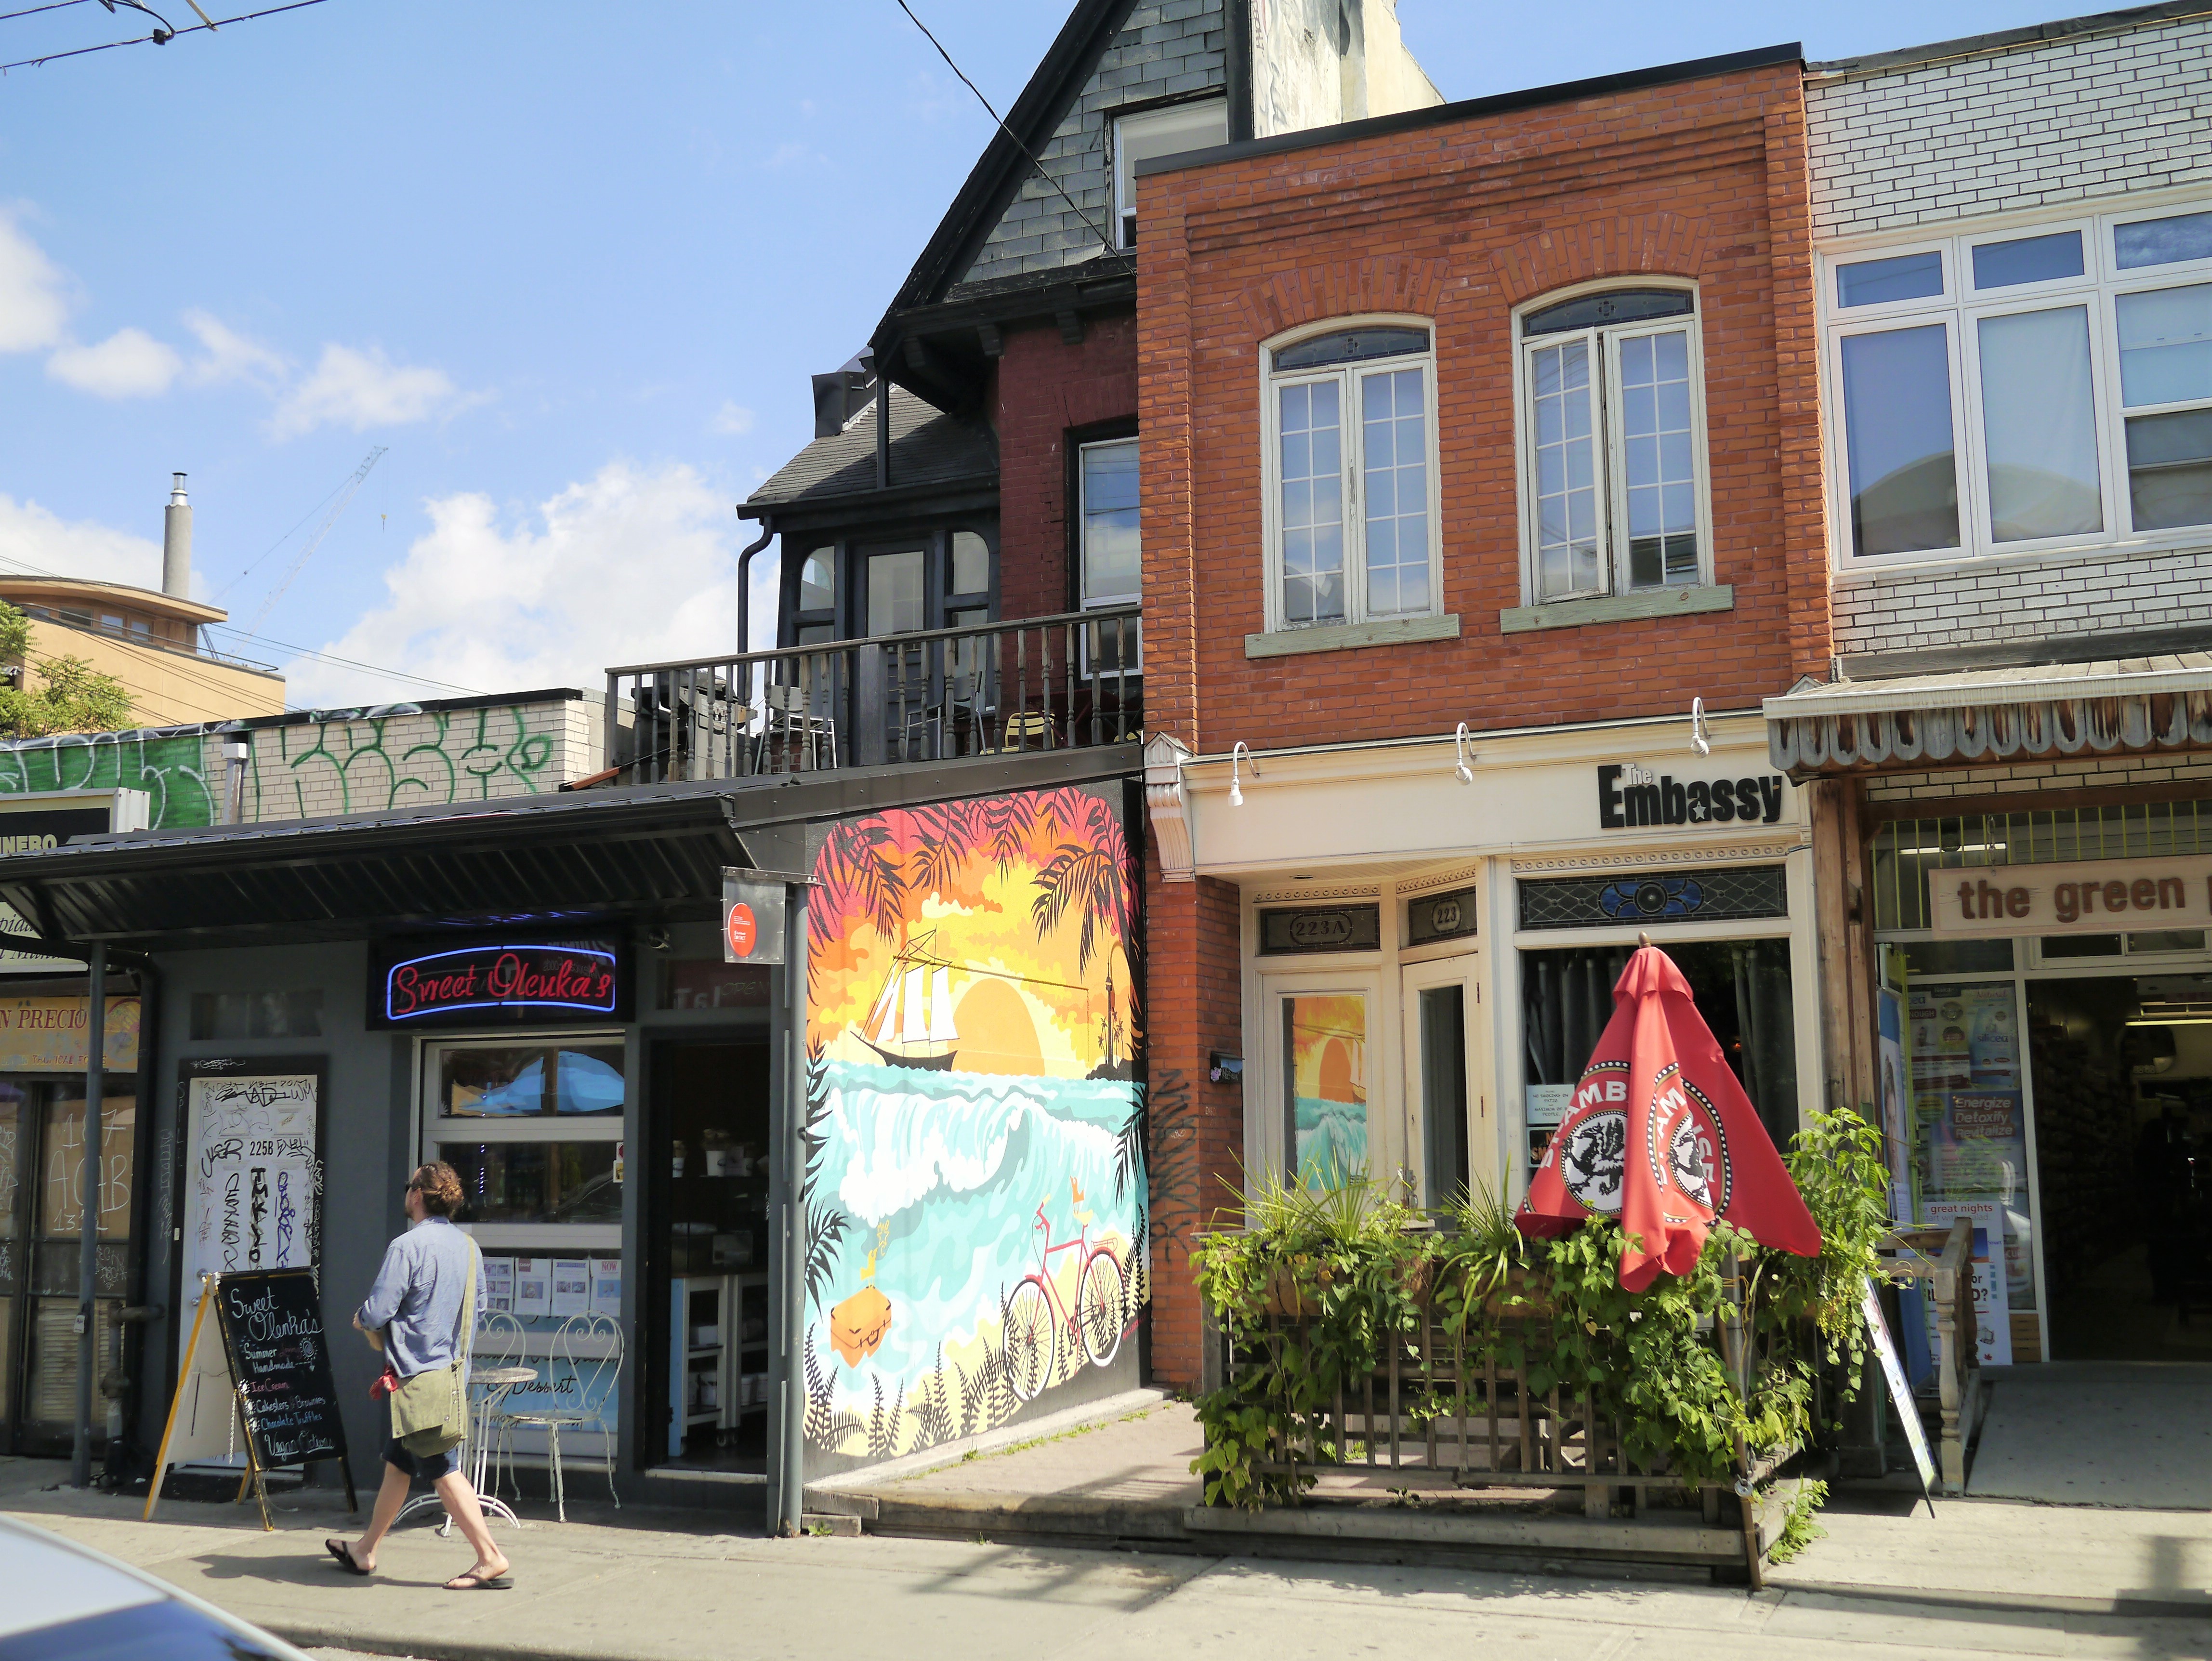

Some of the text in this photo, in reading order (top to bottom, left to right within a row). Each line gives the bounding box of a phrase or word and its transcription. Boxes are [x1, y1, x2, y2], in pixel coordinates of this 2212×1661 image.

[1622, 763, 1652, 785] The
[1597, 765, 1782, 829] Embassy
[0, 834, 57, 855] NERO
[1957, 880, 2030, 919] the
[2054, 876, 2186, 923] green
[1437, 906, 1457, 924] 223
[1296, 920, 1346, 936] 223A
[396, 965, 477, 1013] Sweet
[17, 1009, 88, 1029] PRECIO
[1955, 1096, 2011, 1110] Energize
[1955, 1111, 2009, 1125] Detoxify
[1956, 1125, 2013, 1138] Revitalize
[250, 1140, 274, 1156] 225B
[1931, 1204, 1958, 1214] great
[1961, 1203, 1992, 1214] nights
[602, 1261, 618, 1272] NOW
[230, 1286, 279, 1318] Sweet
[249, 1309, 324, 1341] Olenka's
[244, 1342, 277, 1360] Summer
[252, 1357, 295, 1374] Handmade
[250, 1378, 290, 1393] Ice Cream
[512, 1375, 578, 1395] Dessert
[295, 1395, 326, 1409] Brownies
[261, 1411, 323, 1431] Chocolate Truffles
[264, 1432, 297, 1462] Vegan
